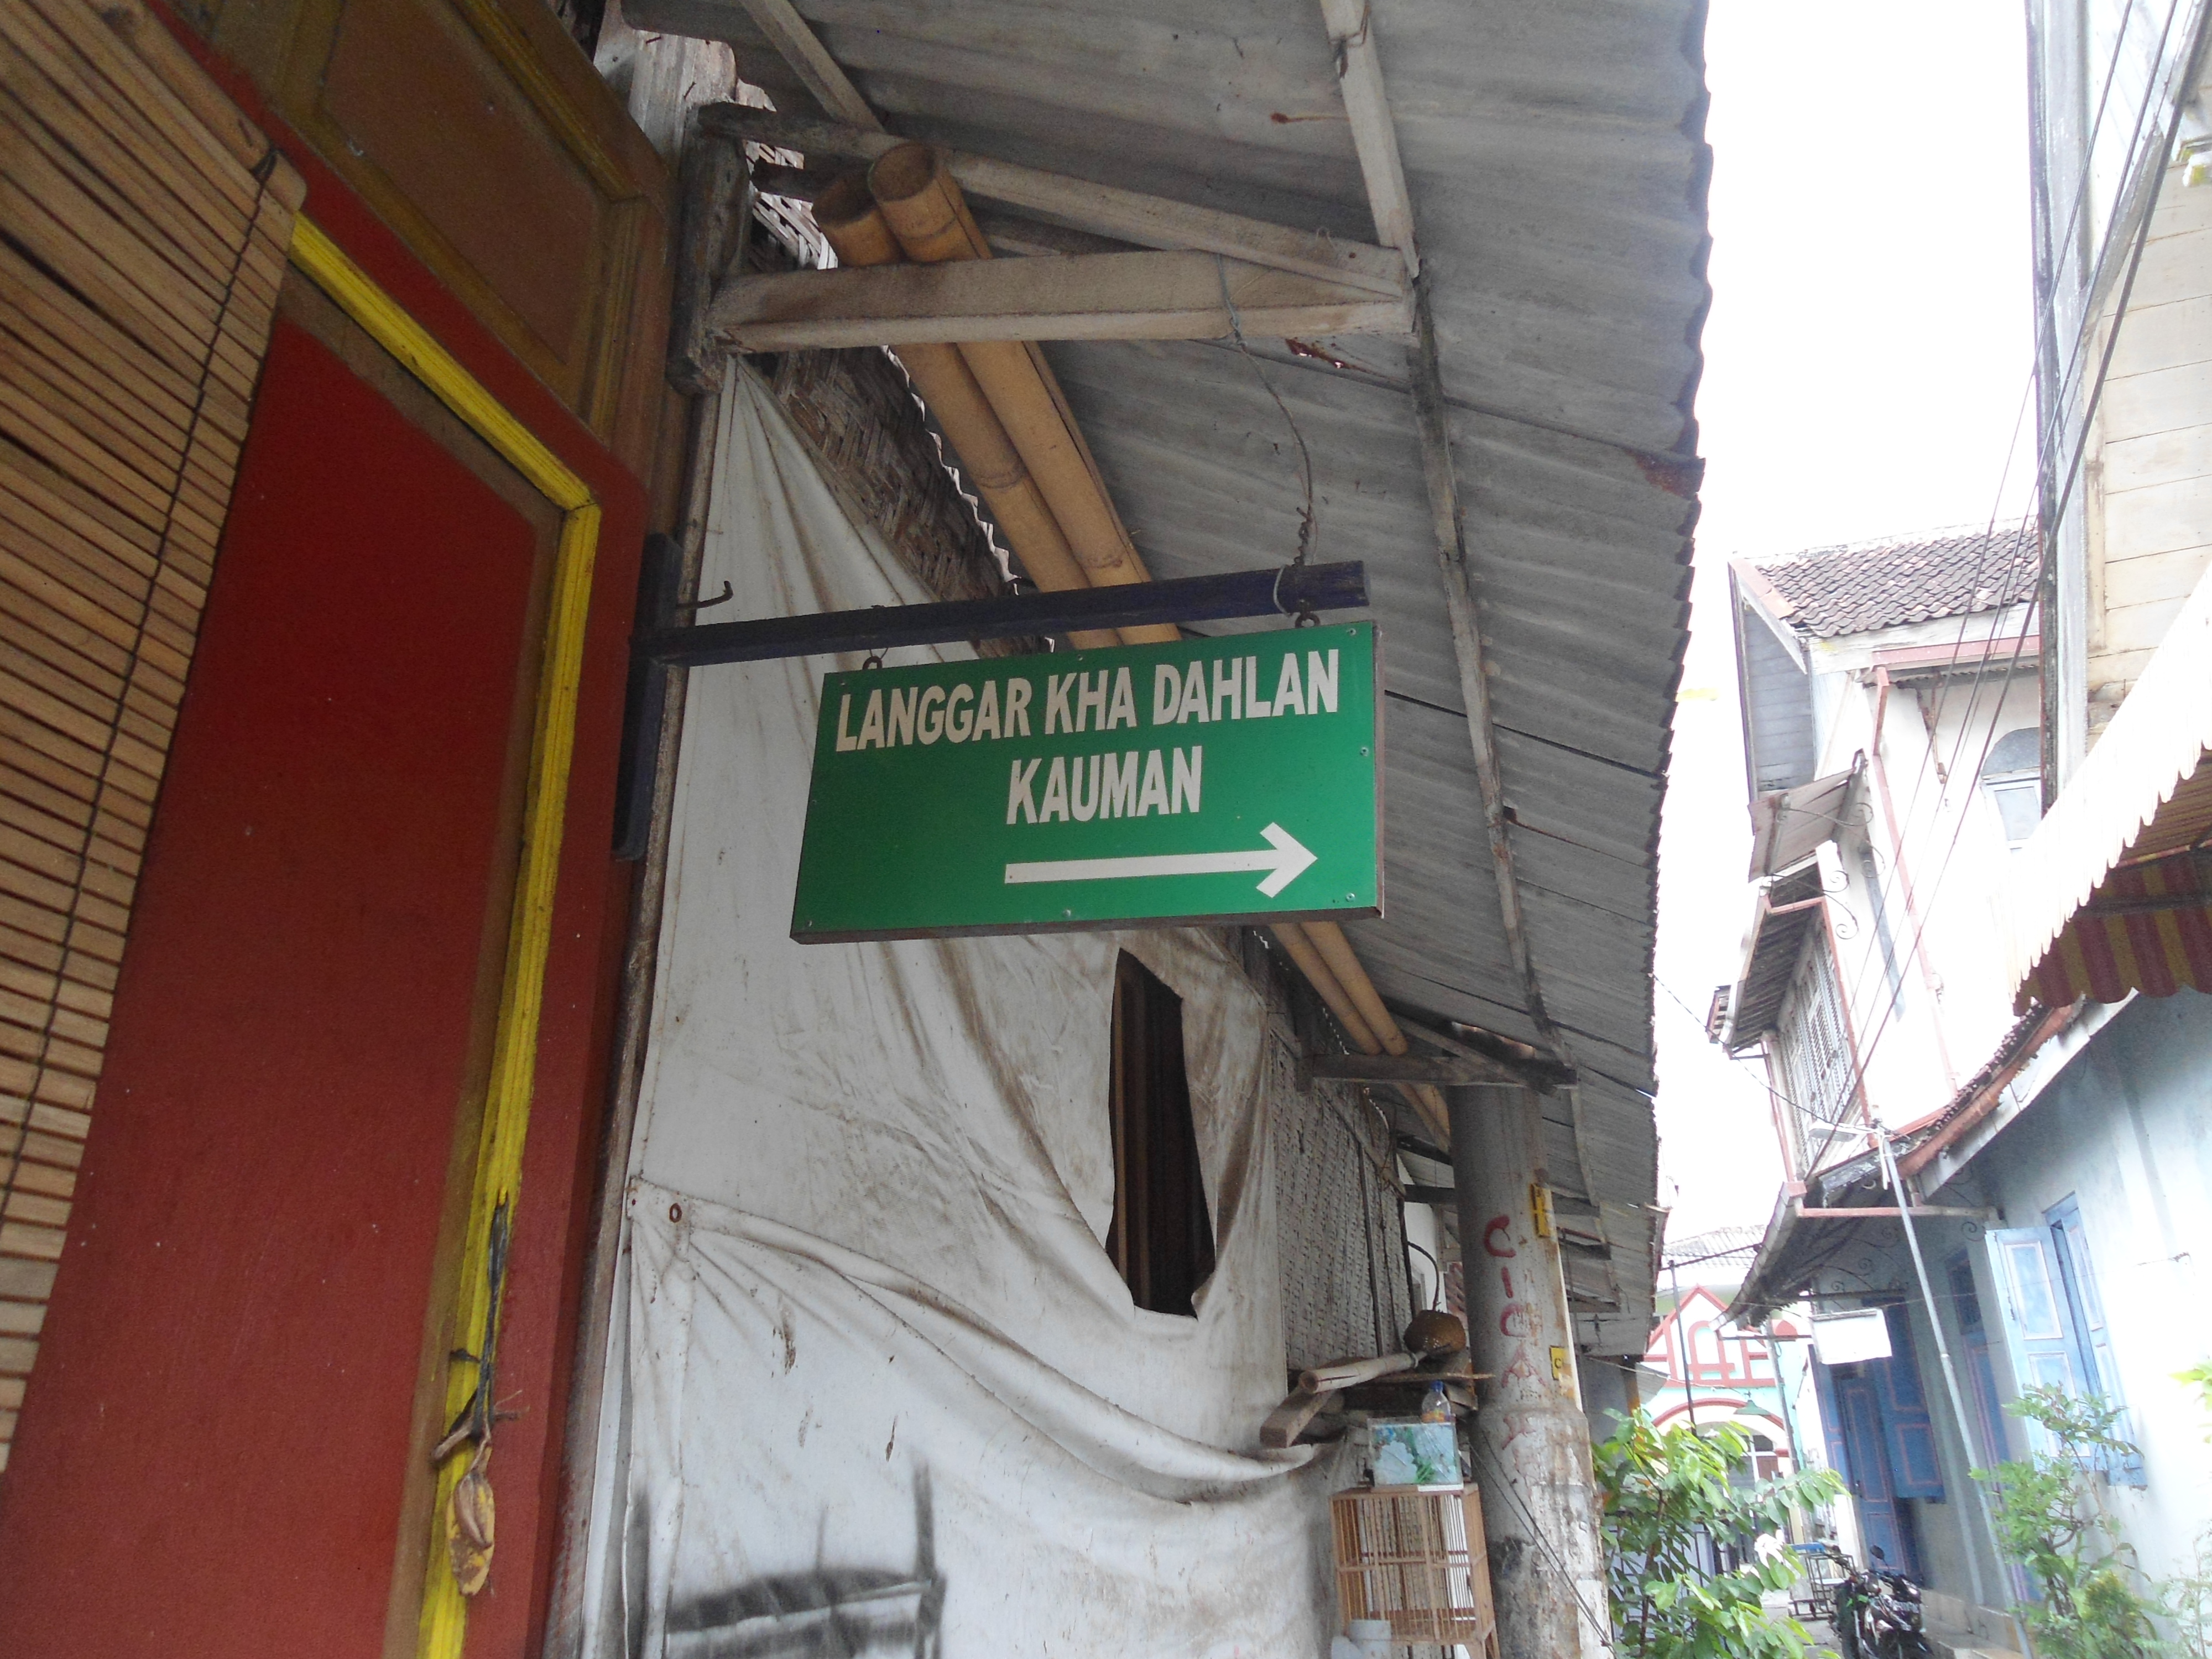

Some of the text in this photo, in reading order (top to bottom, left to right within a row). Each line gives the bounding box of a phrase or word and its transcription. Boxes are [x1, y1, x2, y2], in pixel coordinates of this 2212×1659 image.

[836, 649, 1339, 752] LANGGAR KHA DAHLAN
[1006, 745, 1203, 825] KAUMAN
